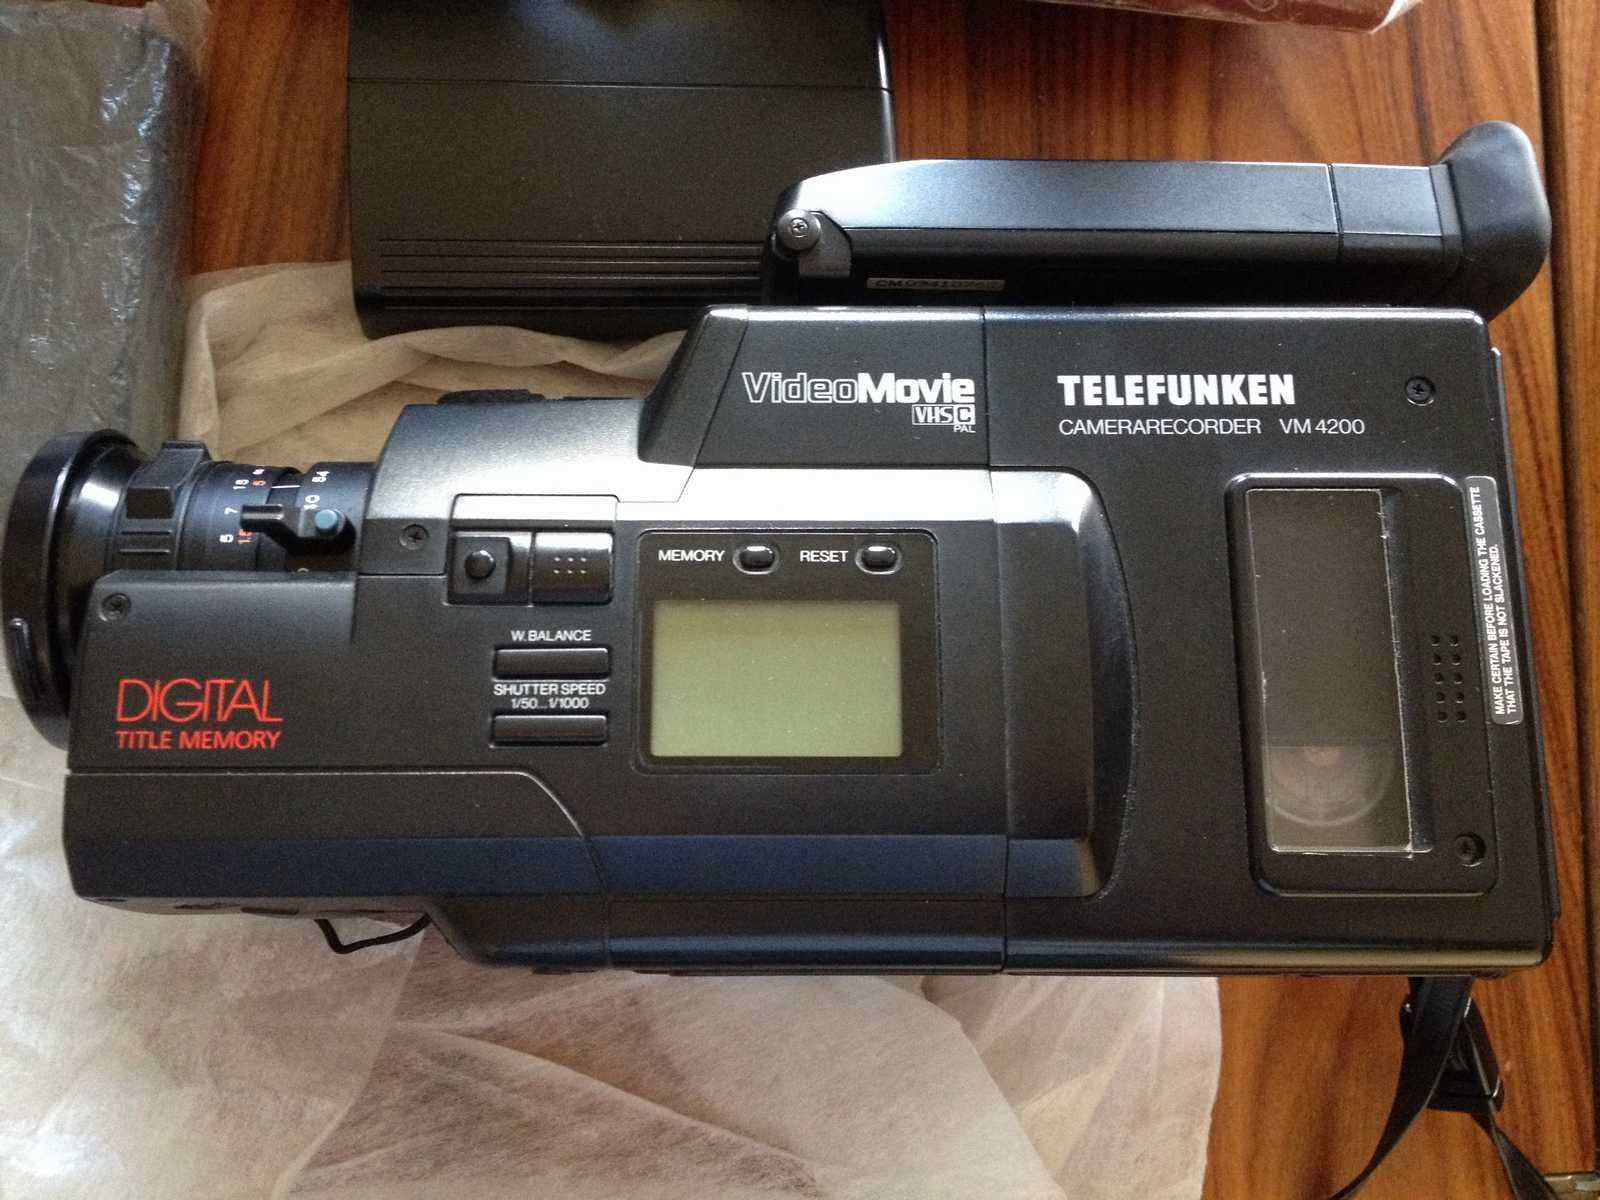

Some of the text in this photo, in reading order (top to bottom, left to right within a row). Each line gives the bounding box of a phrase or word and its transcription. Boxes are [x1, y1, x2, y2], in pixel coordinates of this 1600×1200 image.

[742, 372, 976, 404] VideoMovie
[1057, 374, 1296, 406] TELEFUNKEN
[953, 424, 976, 433] PAL
[1058, 418, 1366, 436] CAMERARECORDER VM 4200
[223, 507, 239, 516] 7
[658, 549, 725, 562] MEMORY
[799, 550, 849, 563] RESET
[1470, 487, 1505, 714] MAKE CERTAIN BEFORE LOADING THE CASSETTE
[1489, 544, 1518, 714] THAT THE TAPE IS NOT SLACKENED.
[493, 682, 606, 696] SHUTTER SPEED
[116, 677, 284, 723] DIGITAL
[115, 730, 282, 750] TITLE MEMORY
